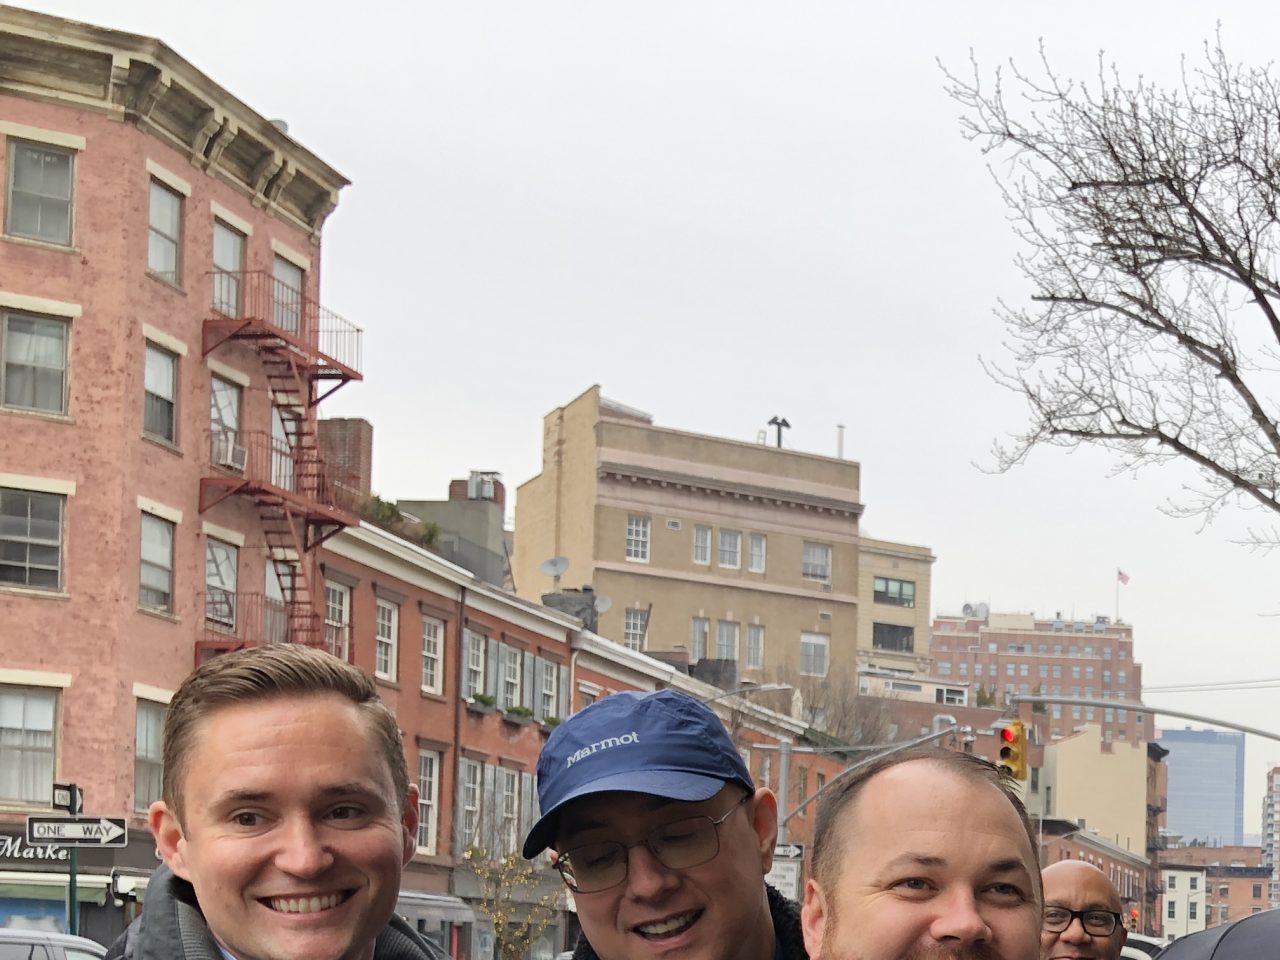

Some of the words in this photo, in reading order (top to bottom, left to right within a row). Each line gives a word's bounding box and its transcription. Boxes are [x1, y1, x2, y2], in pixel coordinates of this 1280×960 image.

[566, 731, 640, 768] Marmot
[36, 824, 65, 837] ONE
[82, 824, 113, 837] WAY
